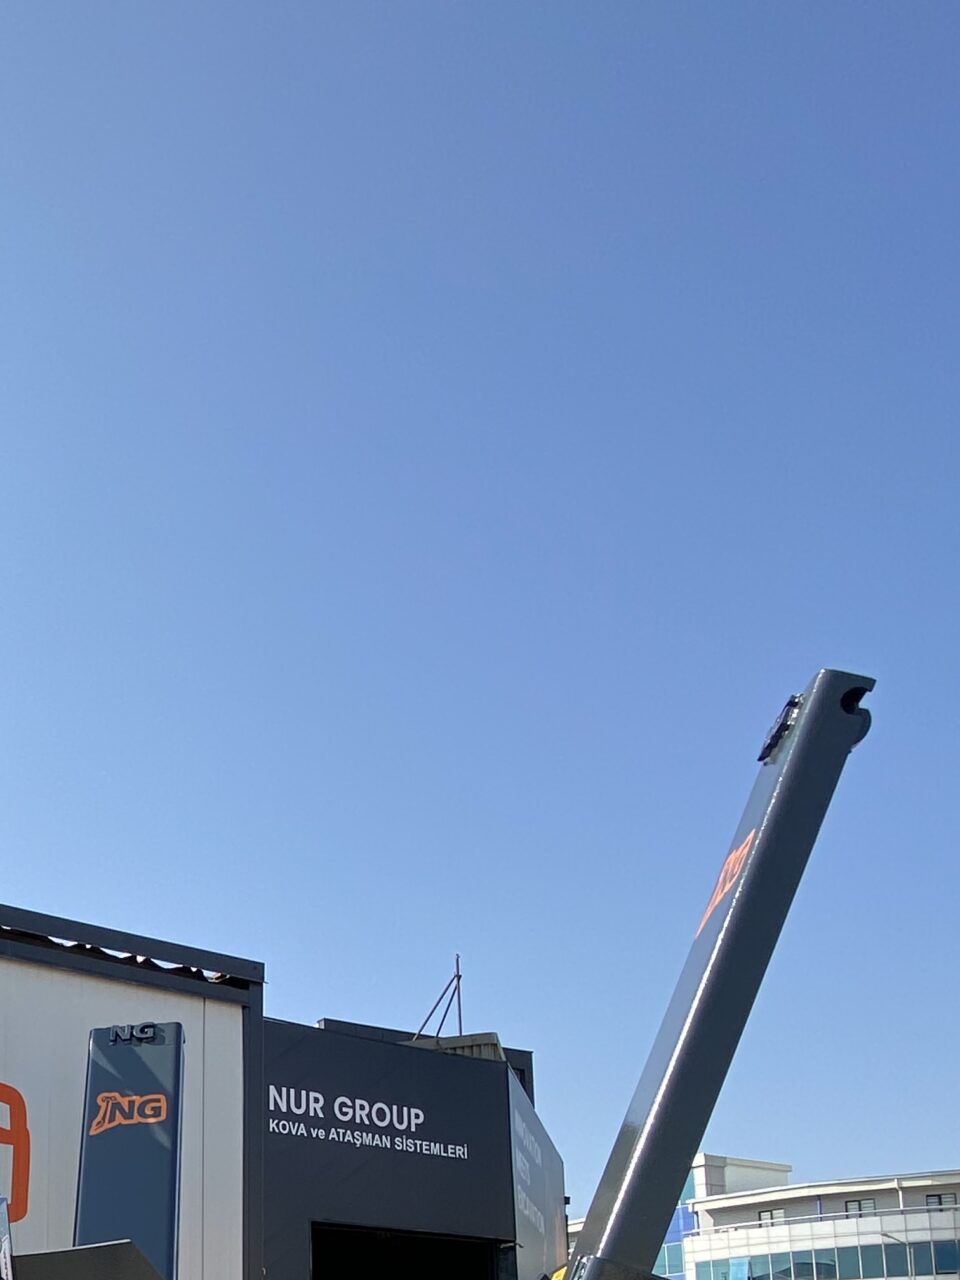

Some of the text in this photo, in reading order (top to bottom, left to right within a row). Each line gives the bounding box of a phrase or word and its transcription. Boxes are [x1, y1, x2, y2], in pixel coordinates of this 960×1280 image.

[109, 1022, 155, 1042] NG
[269, 1085, 425, 1132] NUR GROUP
[269, 1119, 468, 1160] KOVA ve ATAŞMAN SİSTEMLERİ
